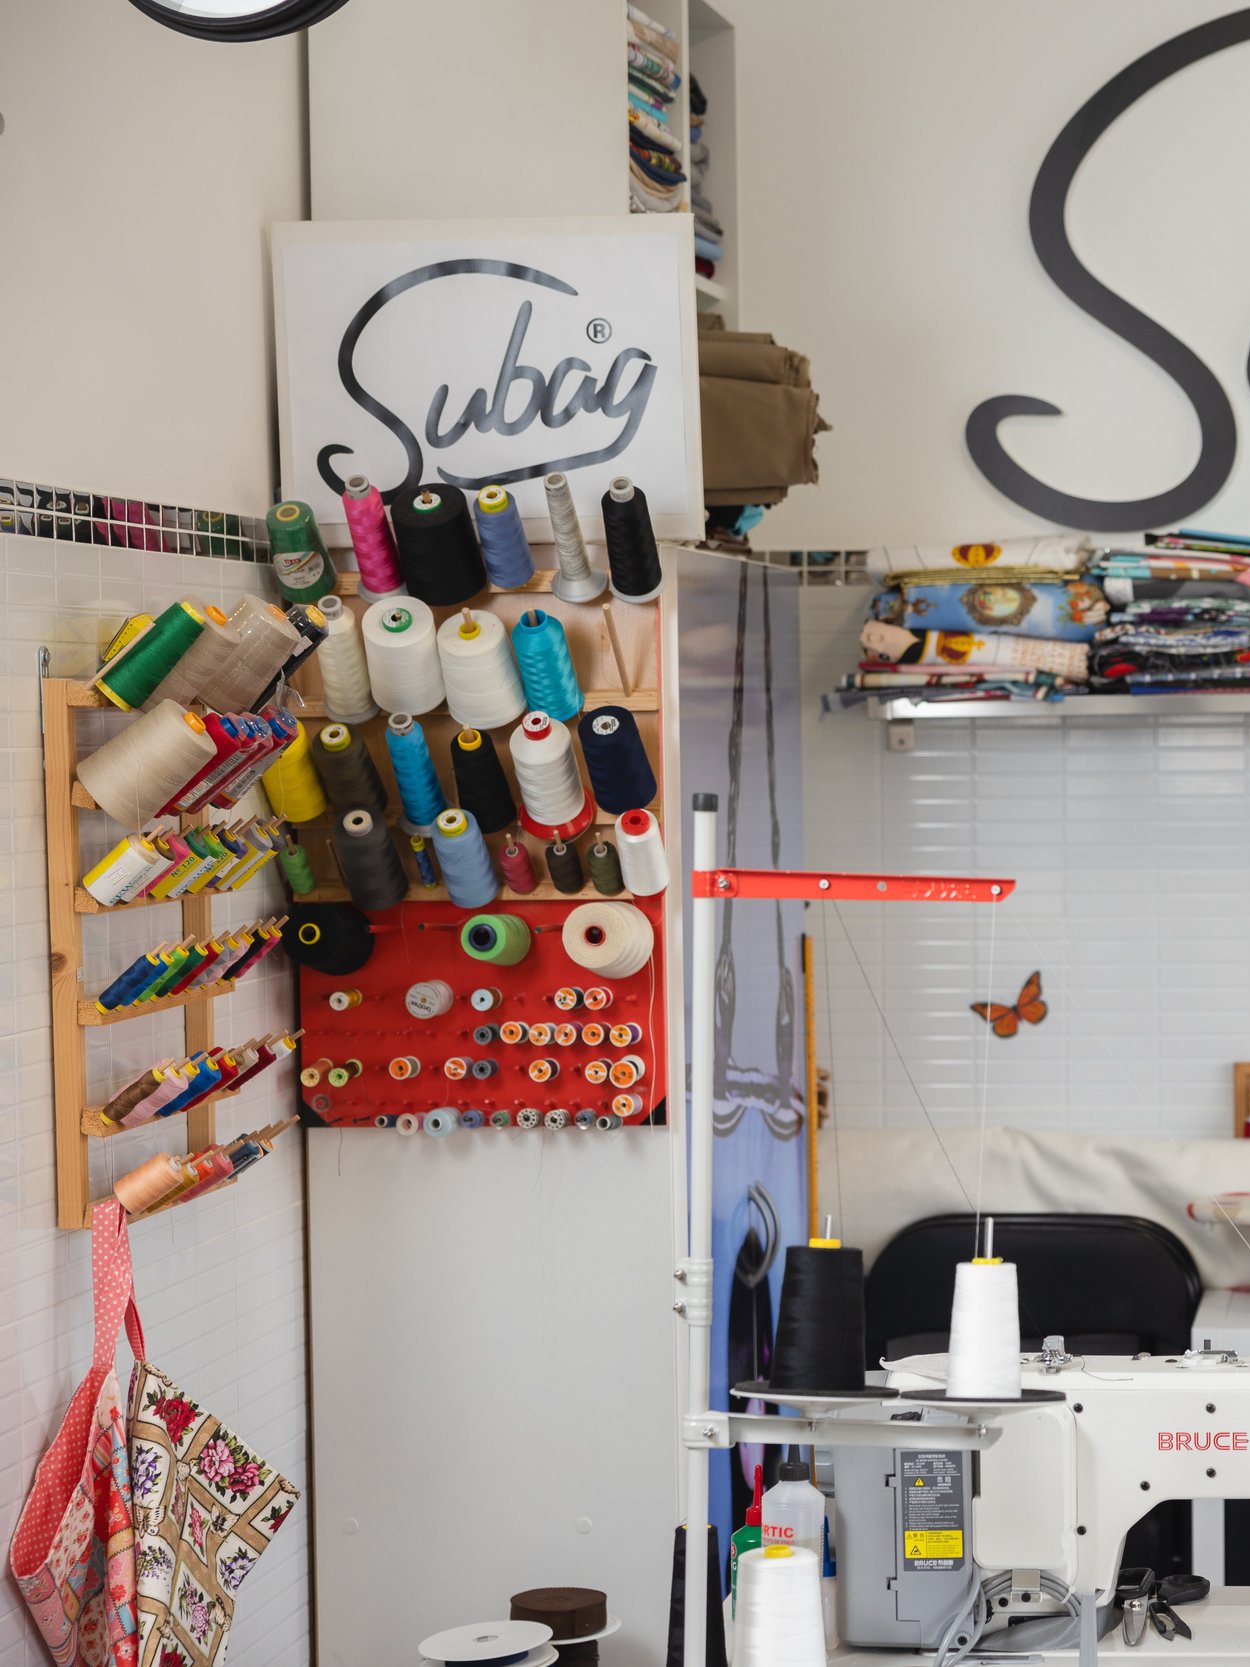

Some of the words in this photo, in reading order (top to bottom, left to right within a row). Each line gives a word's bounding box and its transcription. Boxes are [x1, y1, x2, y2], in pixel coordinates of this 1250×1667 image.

[317, 258, 657, 505] Subag
[182, 857, 195, 868] 120
[1158, 1432, 1249, 1451] BRUCE
